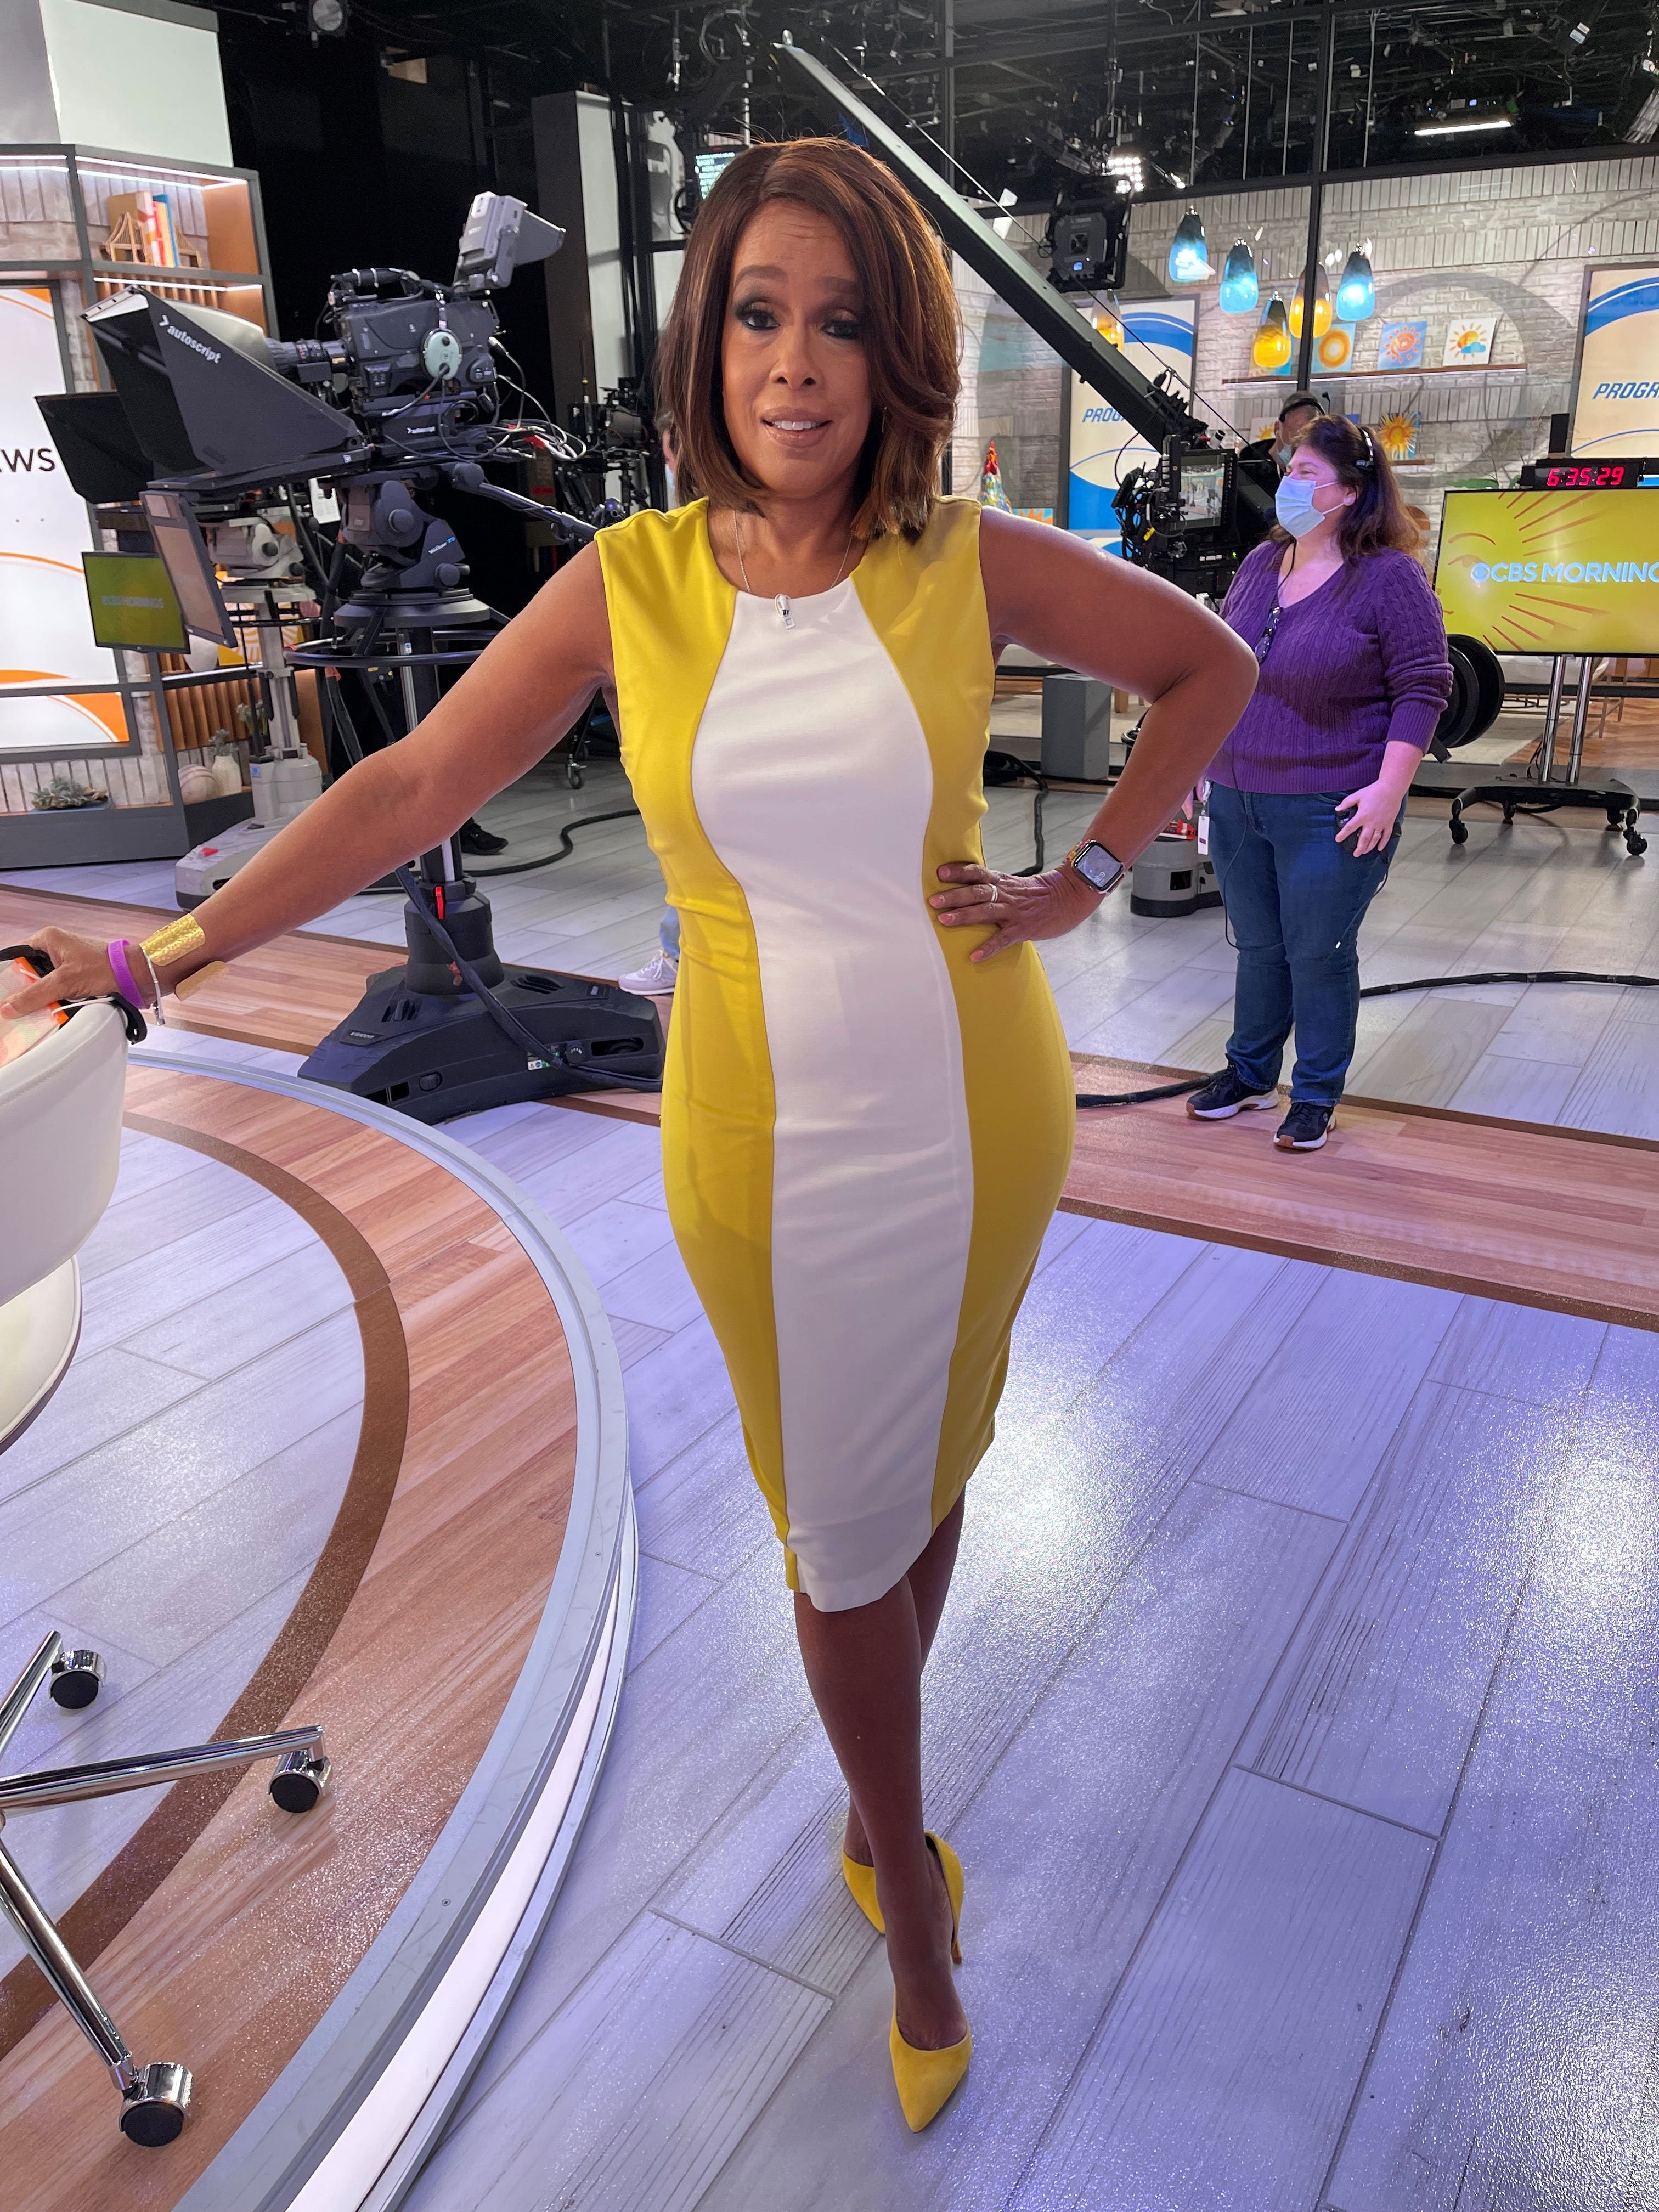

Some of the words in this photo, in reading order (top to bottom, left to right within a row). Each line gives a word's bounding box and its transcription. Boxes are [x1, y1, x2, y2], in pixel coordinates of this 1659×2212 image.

[167, 325, 221, 364] autoscript
[0, 448, 55, 472] WS
[1547, 467, 1624, 487] 6:35:29
[1491, 562, 1538, 582] CBS
